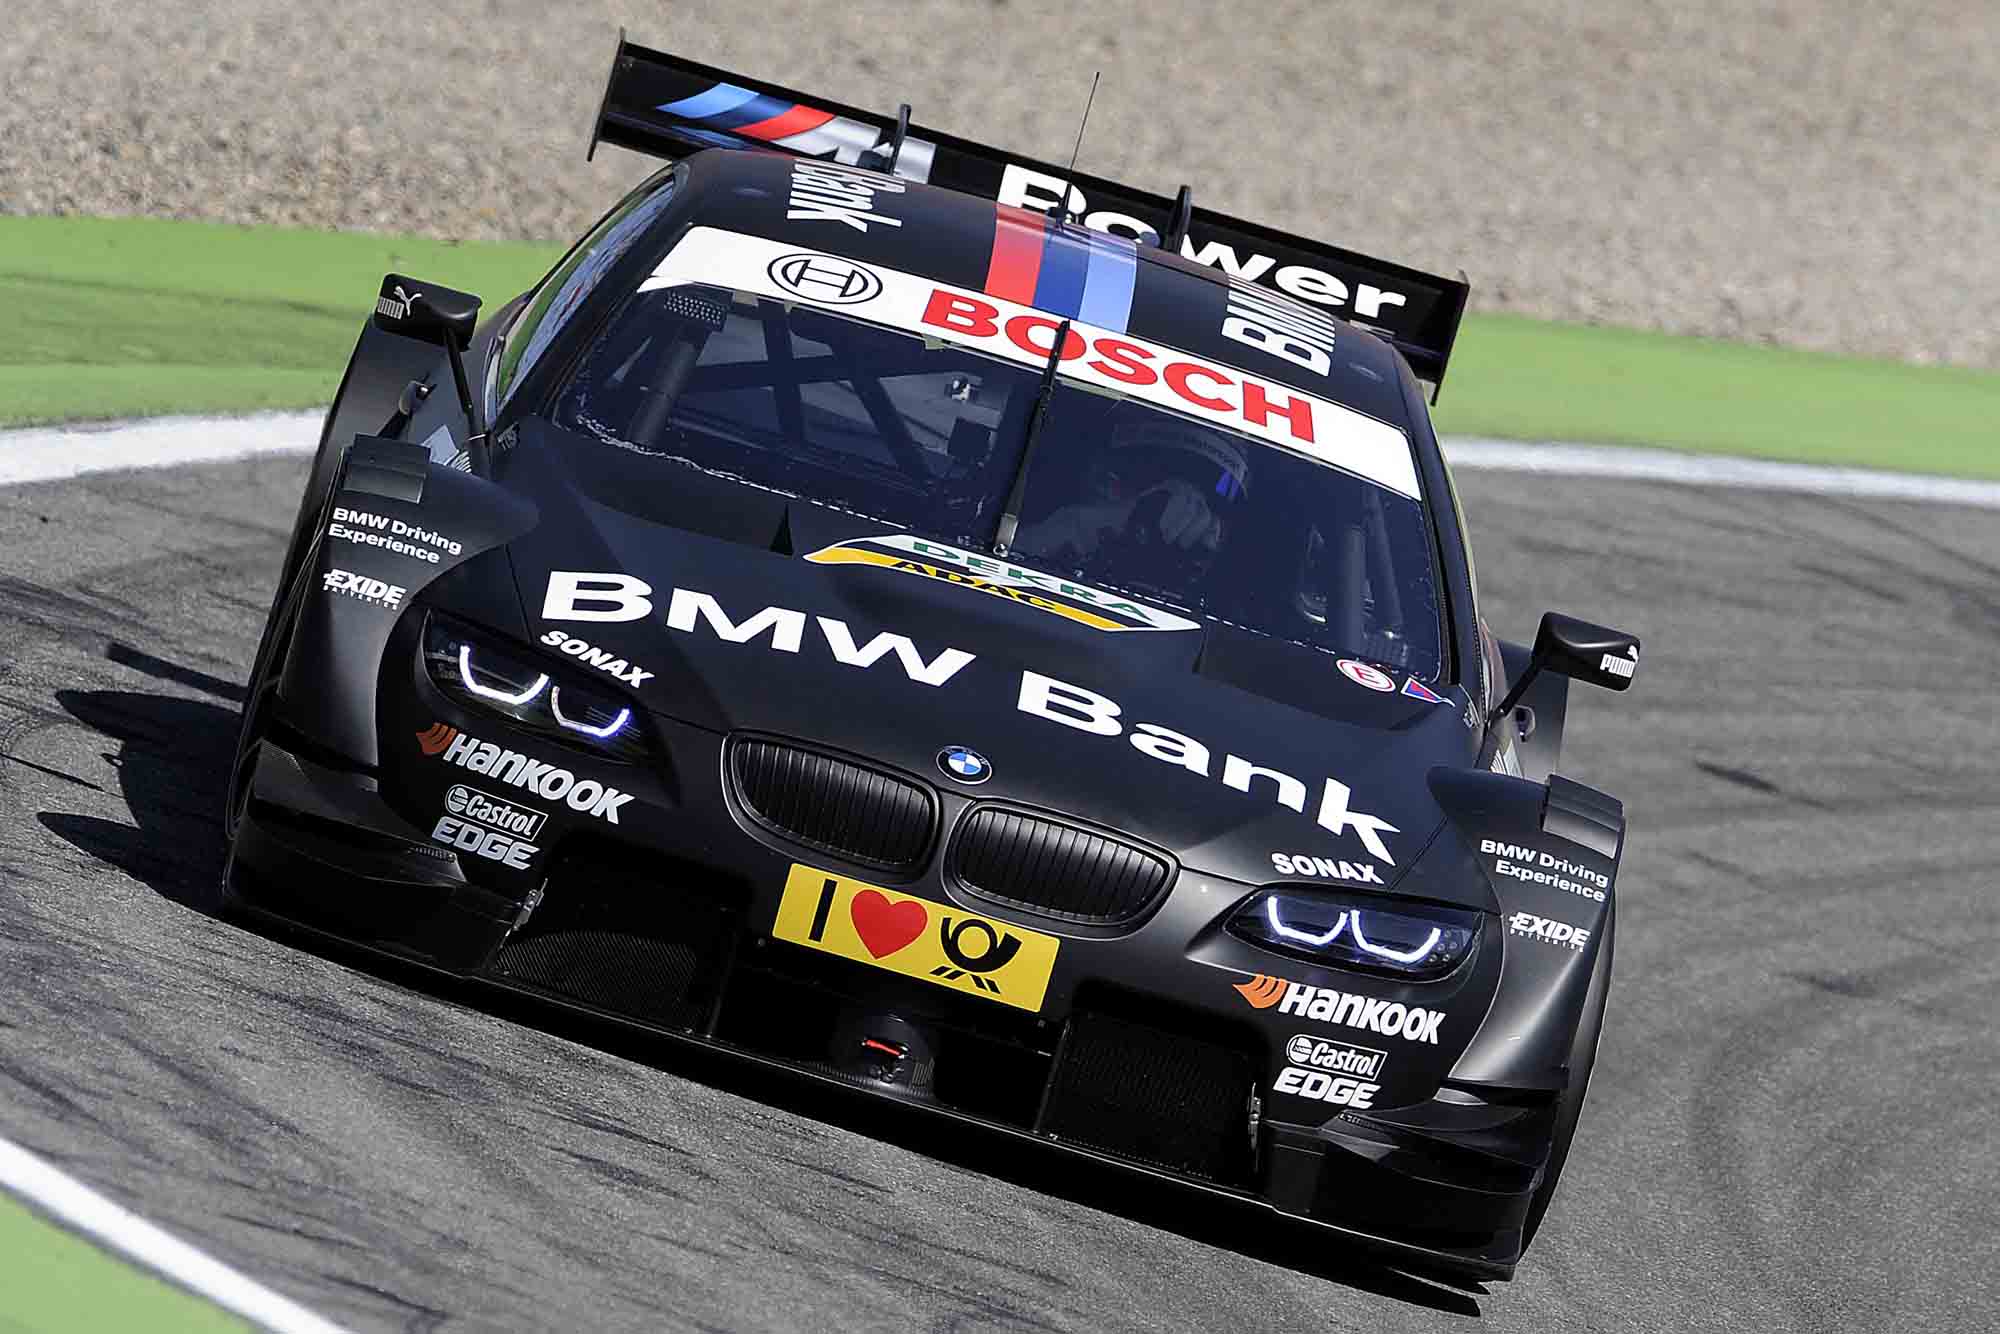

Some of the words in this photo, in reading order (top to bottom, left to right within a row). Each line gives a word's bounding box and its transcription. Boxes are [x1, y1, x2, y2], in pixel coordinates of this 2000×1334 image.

[921, 288, 1315, 443] BOSCH
[328, 523, 441, 564] Experience
[332, 507, 389, 530] BMW
[391, 519, 463, 556] Driving
[323, 568, 407, 604] EXIDE
[891, 560, 1058, 613] ADAC
[913, 541, 1154, 622] DEKRA
[540, 630, 655, 688] SONAX
[541, 571, 977, 687] BMW
[1017, 670, 1401, 867] Bank
[465, 794, 539, 836] Castrol
[431, 816, 541, 870] EDGE
[1480, 839, 1537, 862] BMW
[1539, 852, 1609, 888] Driving
[1271, 853, 1385, 885] SONAX
[1495, 859, 1606, 902] Experience
[1508, 911, 1592, 947] EXIDE
[1310, 1042, 1380, 1076] Castrol
[1272, 1066, 1382, 1109] EDGE
